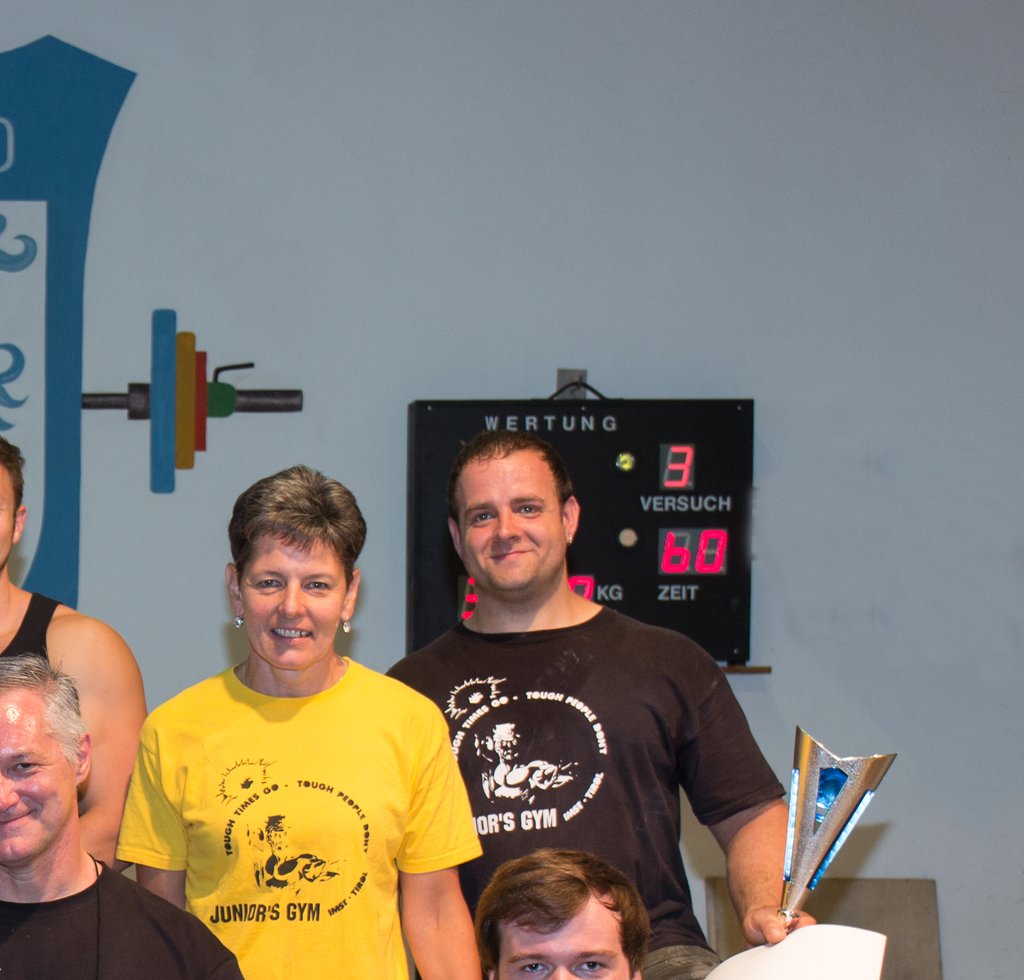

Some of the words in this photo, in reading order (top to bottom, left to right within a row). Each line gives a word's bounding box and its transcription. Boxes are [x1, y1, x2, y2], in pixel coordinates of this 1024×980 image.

[485, 415, 617, 432] WERTUNG
[663, 445, 694, 488] 3
[640, 495, 732, 512] VERSUCH
[661, 529, 729, 573] 60
[597, 585, 623, 602] KG
[657, 585, 699, 602] ZEIT
[462, 704, 489, 729] TIMES
[526, 691, 564, 701] TOUGH
[565, 696, 597, 722] PEOPLE
[223, 819, 236, 856] TOUGH
[233, 793, 260, 816] TIMES
[263, 784, 279, 795] GO
[297, 780, 334, 794] TOUGH
[337, 791, 366, 820] PEOPLE
[520, 808, 558, 830] GYM
[563, 801, 583, 821] IMST
[327, 899, 348, 917] IMST
[350, 871, 368, 897] TIROL
[210, 903, 280, 924] JUNIOR'S
[286, 902, 321, 922] GYM
